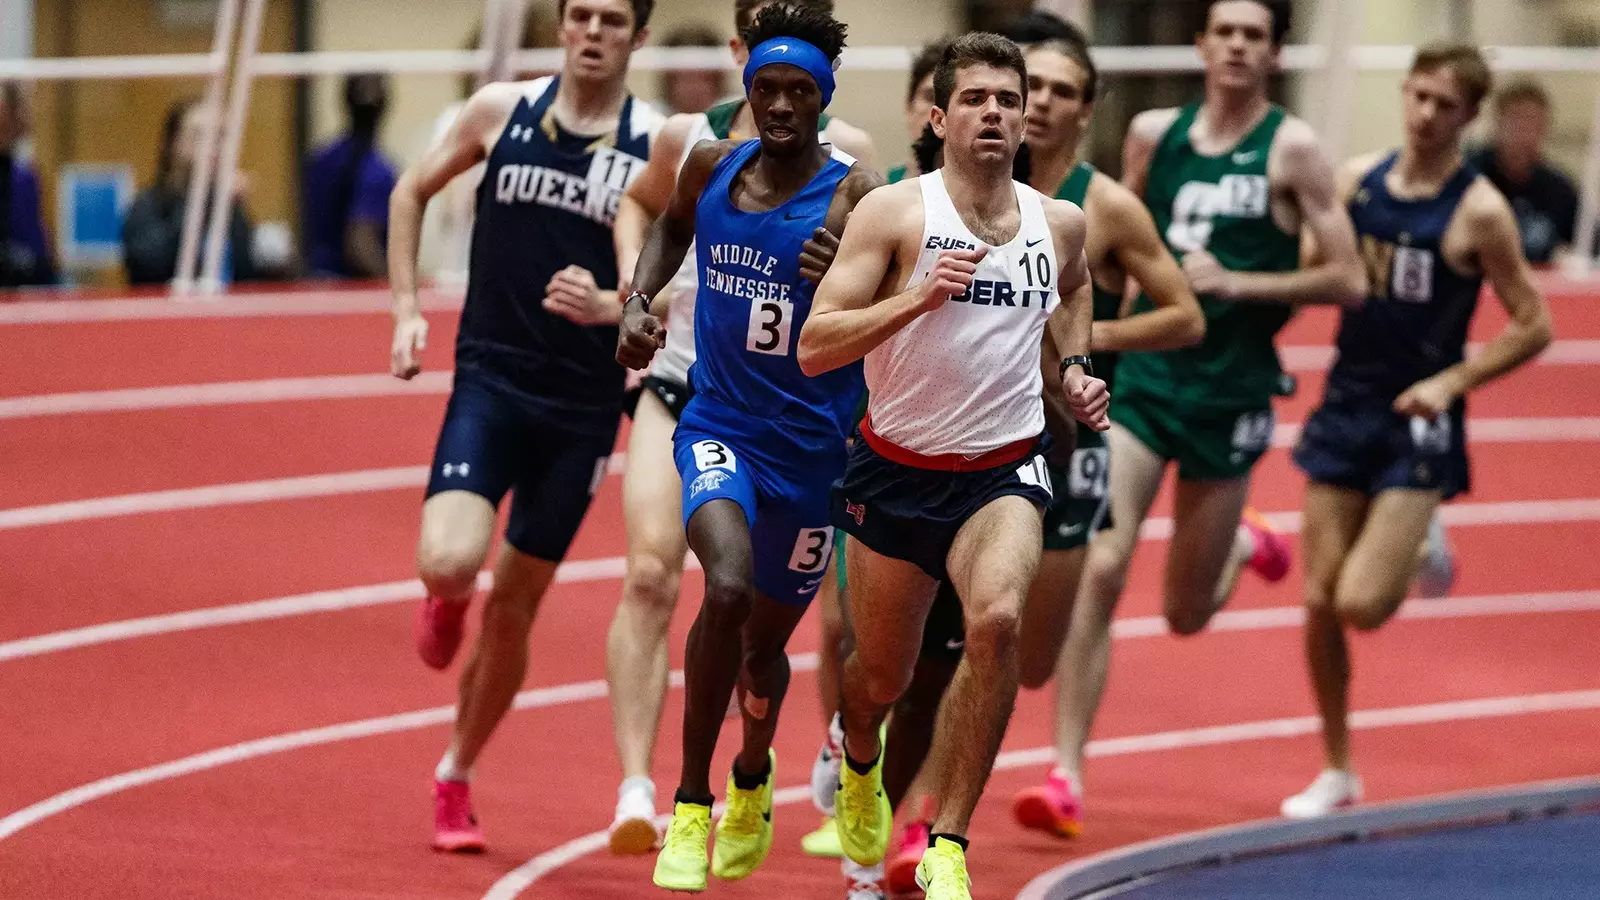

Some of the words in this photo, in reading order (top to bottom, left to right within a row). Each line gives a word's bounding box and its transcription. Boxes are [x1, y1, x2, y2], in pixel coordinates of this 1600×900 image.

[604, 155, 632, 189] 11
[710, 244, 778, 277] MIDDLE
[1018, 252, 1051, 288] 10
[706, 266, 791, 302] TENNESSEE
[755, 302, 783, 351] 3
[702, 441, 727, 467] 3
[797, 530, 827, 571] 3
